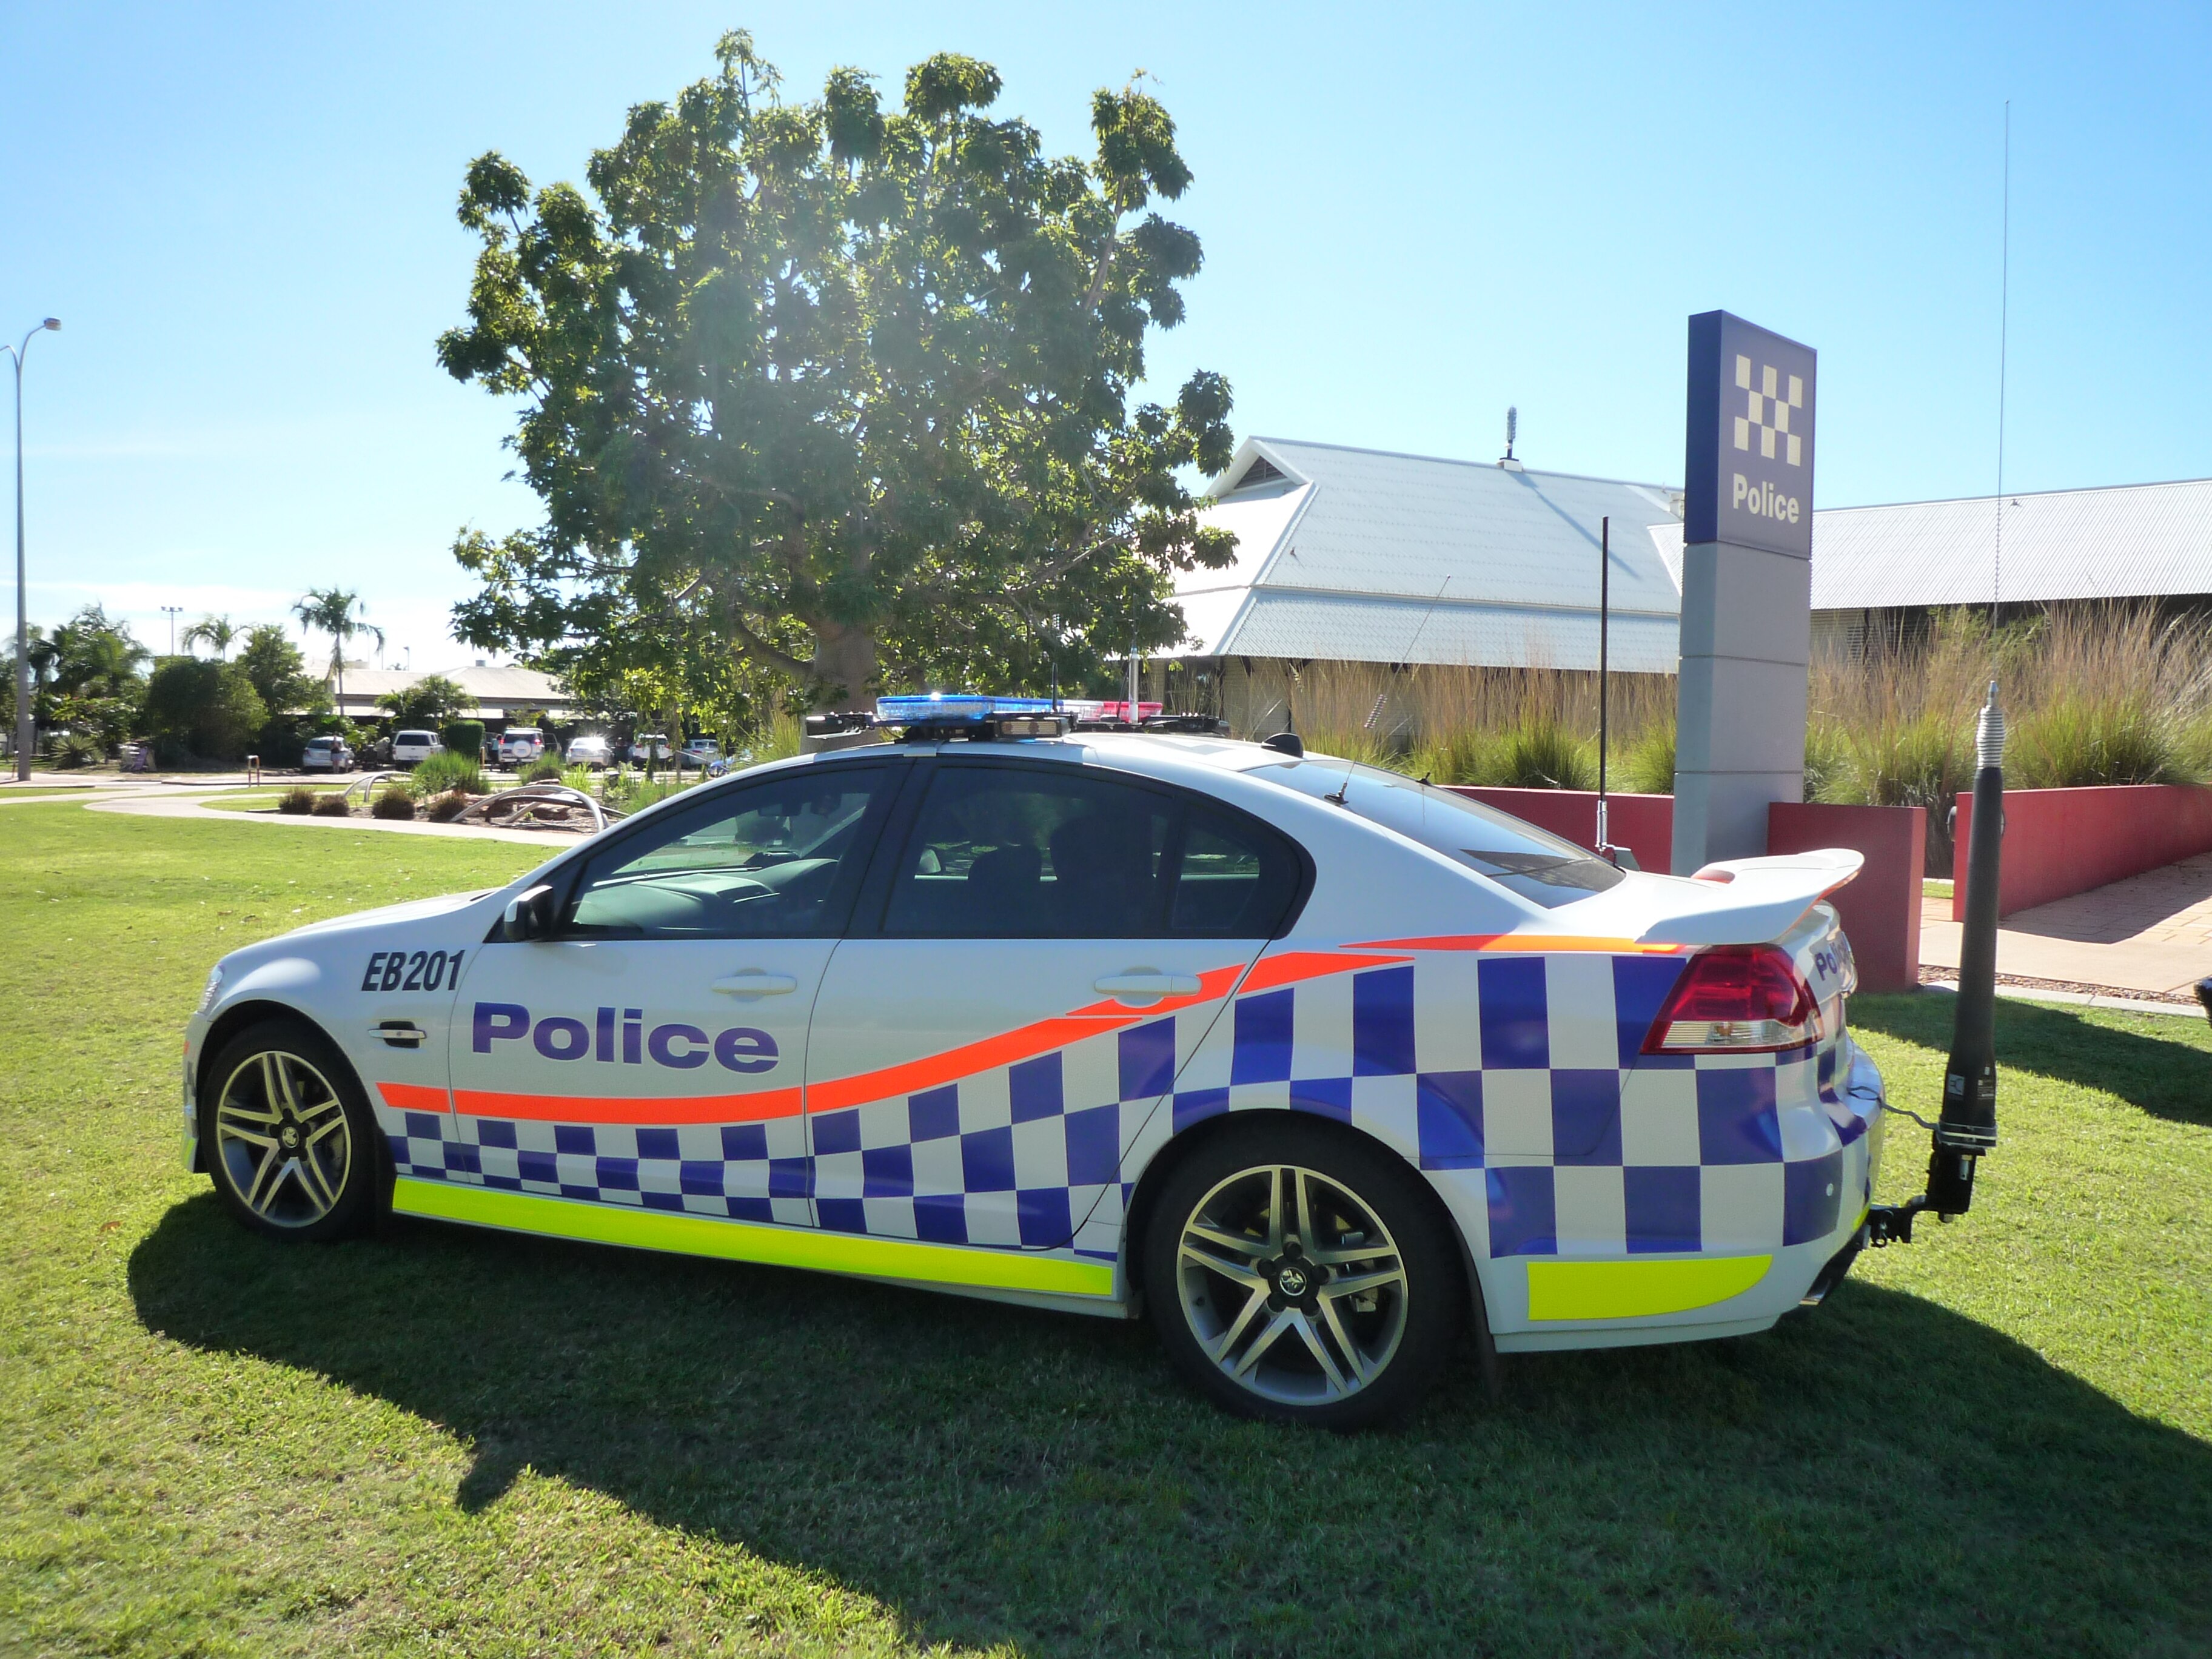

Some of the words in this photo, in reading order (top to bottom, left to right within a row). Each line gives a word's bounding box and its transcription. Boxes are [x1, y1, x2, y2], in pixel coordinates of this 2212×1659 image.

[1733, 473, 1800, 524] Police
[361, 950, 466, 991] EB201
[472, 1001, 779, 1074] Police
